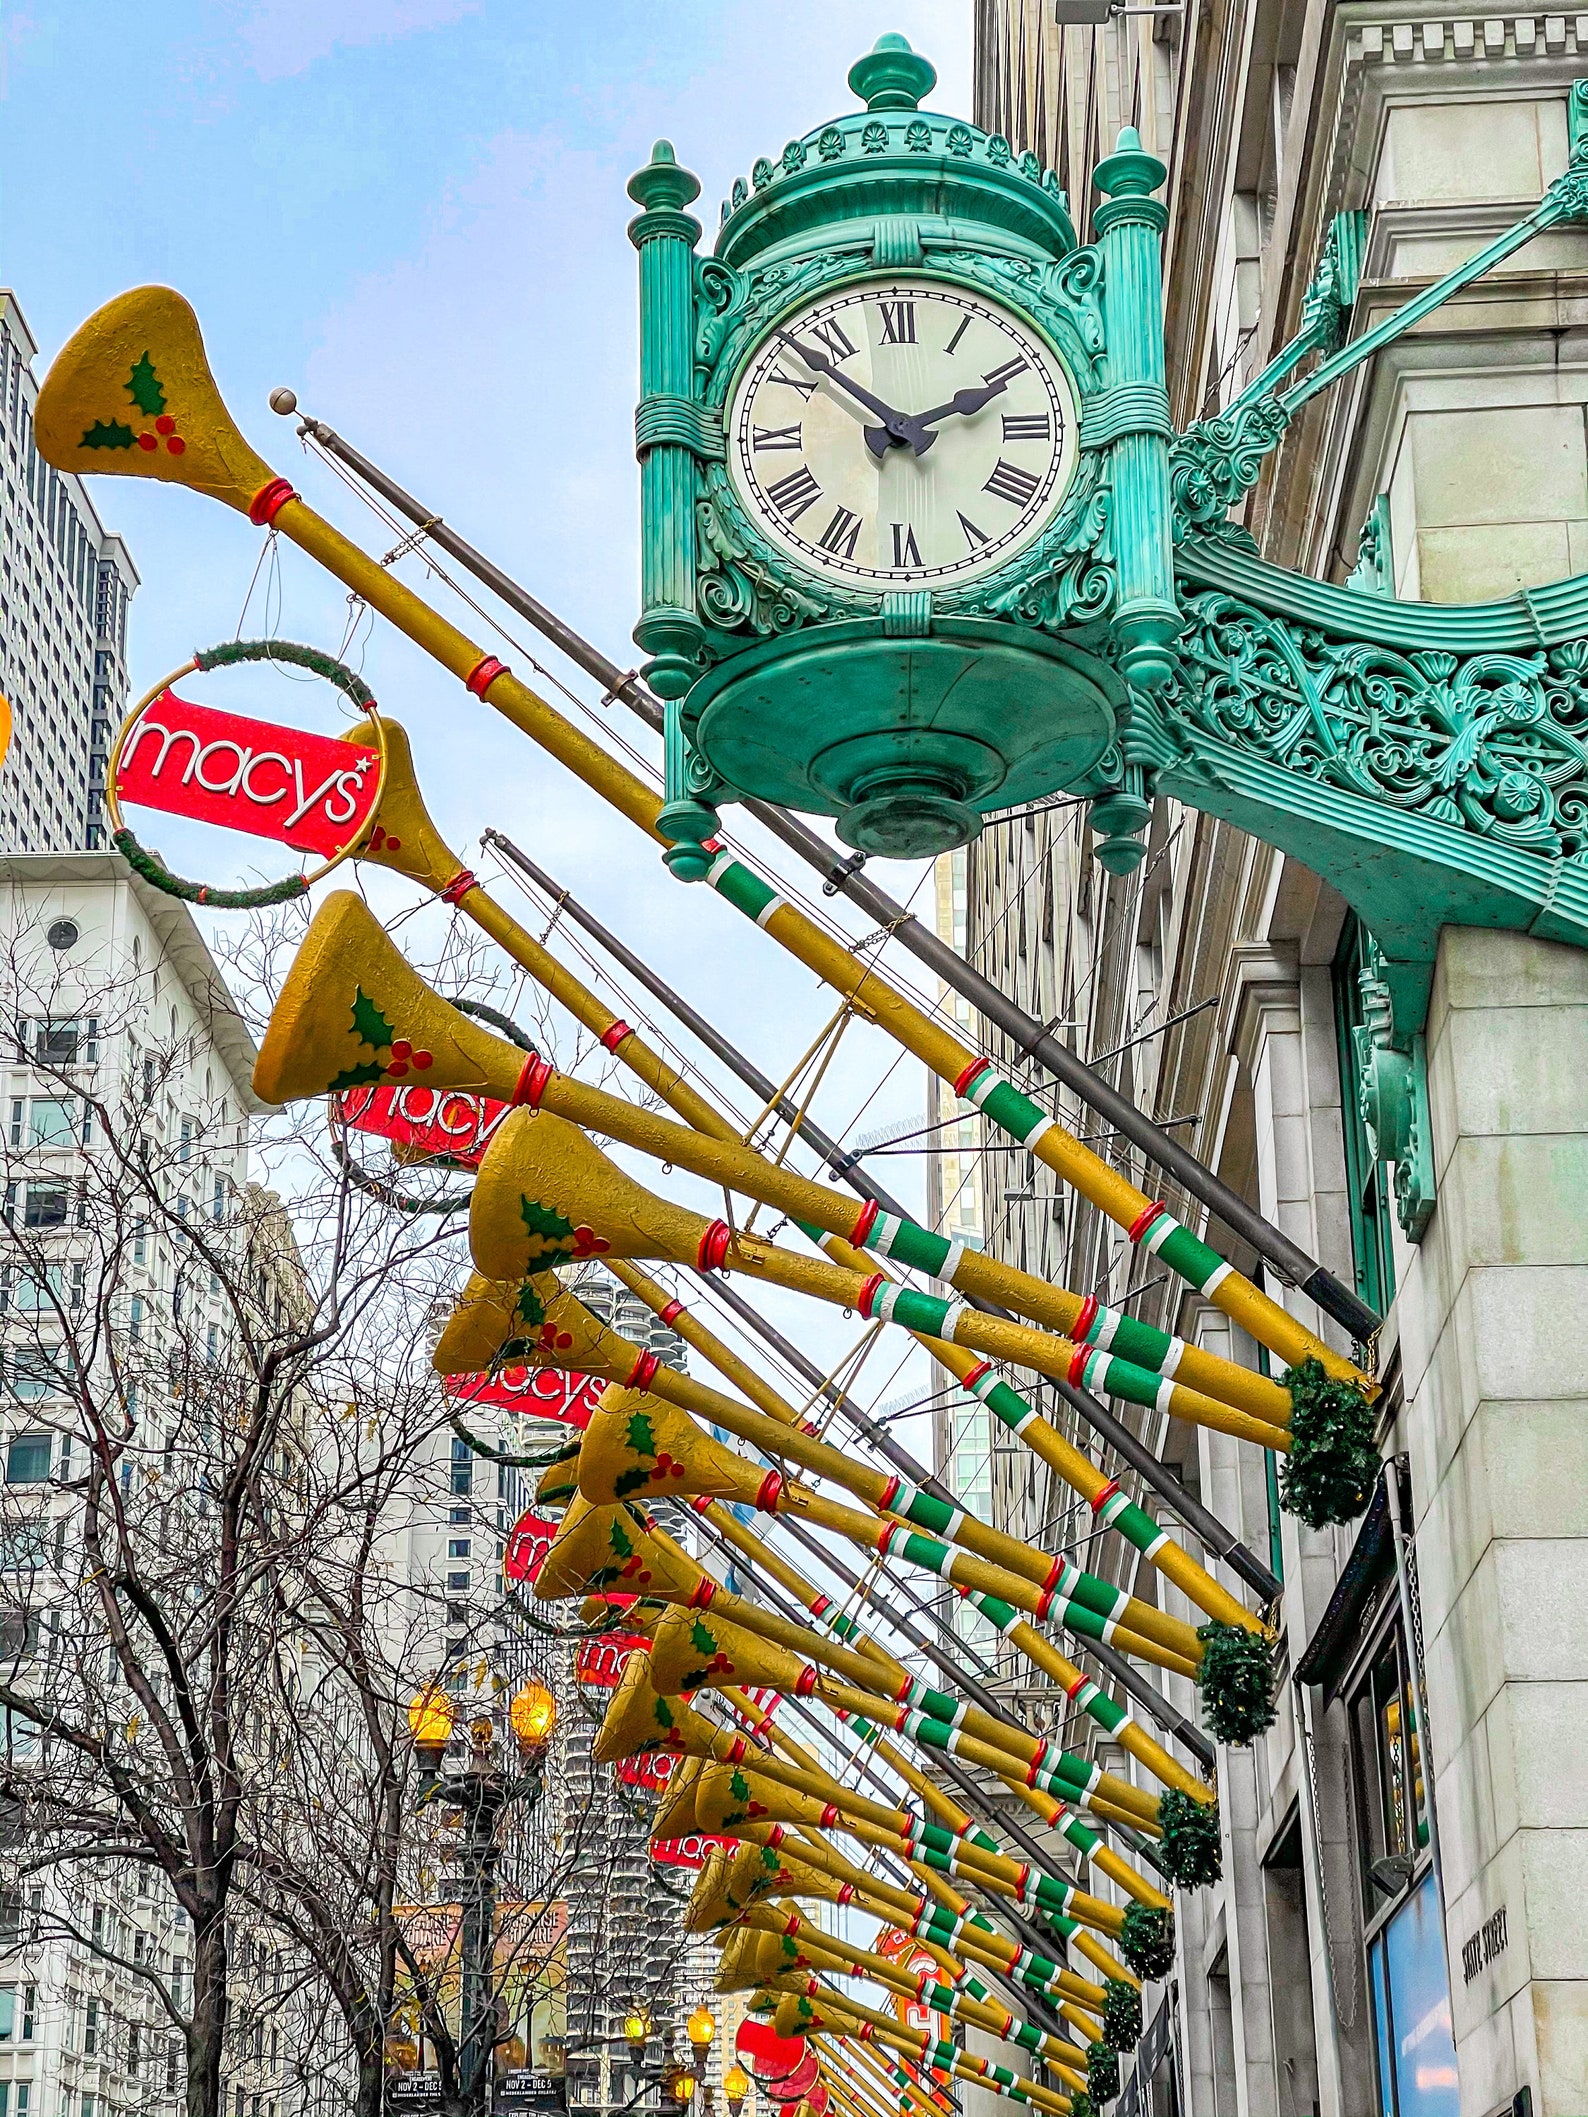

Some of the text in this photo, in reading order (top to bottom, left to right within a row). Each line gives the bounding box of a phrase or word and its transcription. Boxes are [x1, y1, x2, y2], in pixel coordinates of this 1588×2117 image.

[808, 317, 860, 366] XI
[876, 301, 919, 345] XII
[943, 314, 975, 355] I
[766, 363, 819, 402] X
[981, 353, 1032, 386] II
[753, 422, 803, 453] IX
[1001, 412, 1051, 443] III
[765, 464, 824, 526] VIII
[981, 457, 1043, 510] IIII
[816, 505, 864, 561] VII
[890, 523, 926, 568] VI
[956, 510, 993, 551] V
[340, 1085, 512, 1154] acy
[452, 1365, 606, 1415] acys
[398, 2082, 411, 2092] NOV
[412, 2082, 418, 2091] 2
[424, 2081, 438, 2091] DEC
[505, 2079, 520, 2090] NOV
[520, 2079, 526, 2089] 2
[532, 2079, 546, 2089] DEC
